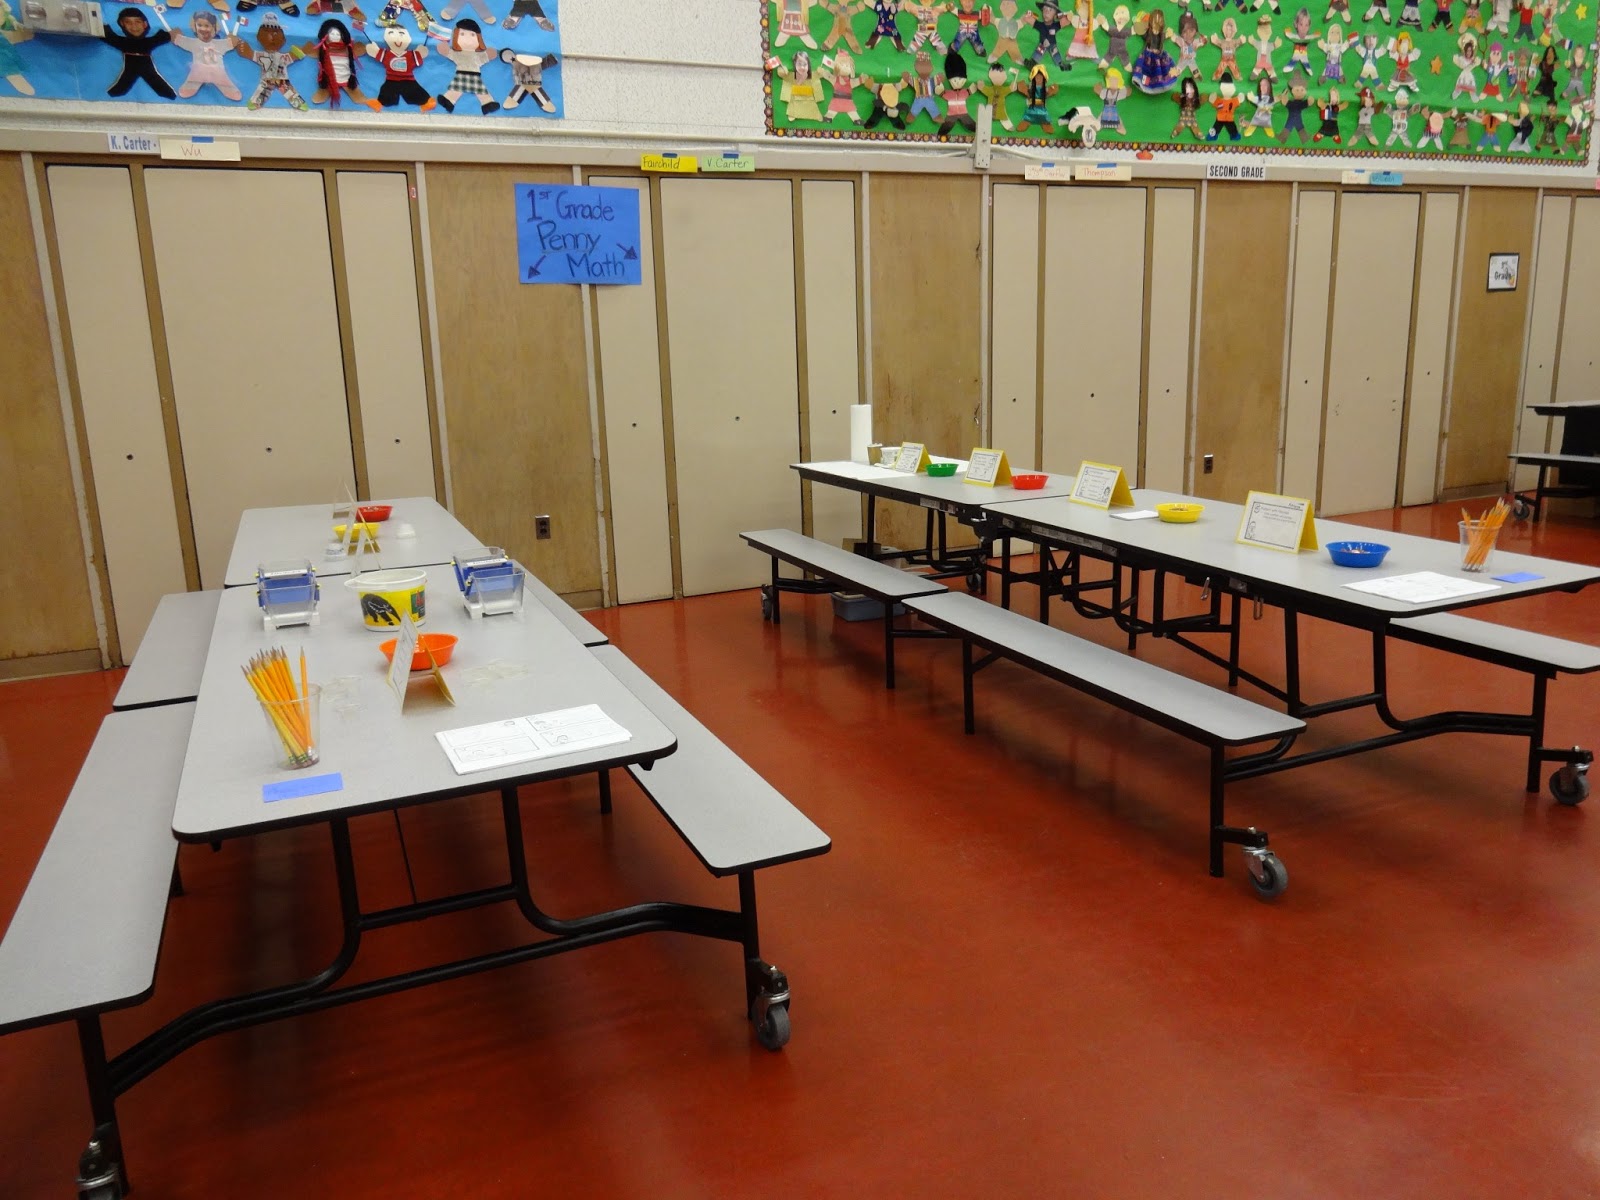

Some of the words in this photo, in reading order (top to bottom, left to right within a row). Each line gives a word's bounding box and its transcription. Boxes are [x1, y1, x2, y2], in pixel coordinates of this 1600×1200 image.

[110, 135, 121, 150] K.
[123, 135, 151, 151] Carter
[180, 144, 203, 157] Wu
[643, 155, 681, 169] Fairchild
[1209, 165, 1239, 178] SECOND
[1241, 166, 1264, 178] GRADE
[556, 190, 615, 222] Grade
[537, 219, 602, 256] Penny
[566, 252, 626, 279] Math
